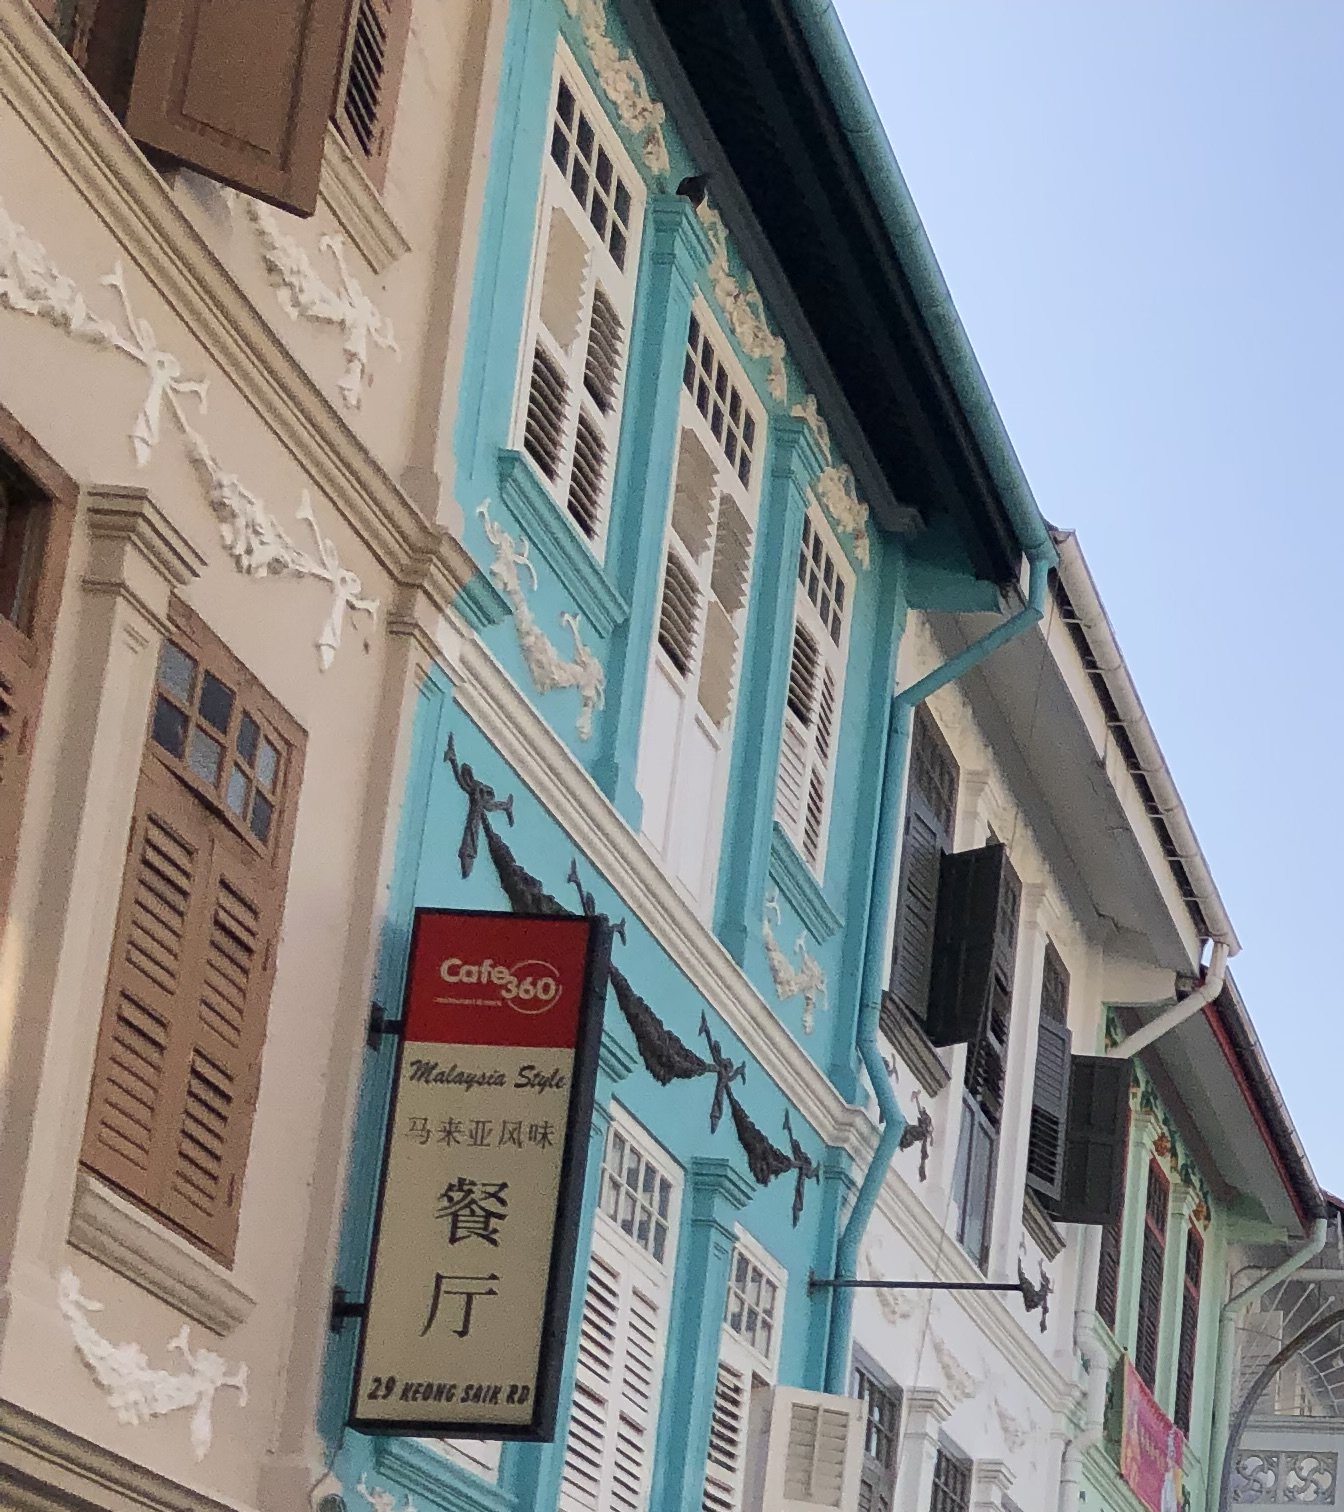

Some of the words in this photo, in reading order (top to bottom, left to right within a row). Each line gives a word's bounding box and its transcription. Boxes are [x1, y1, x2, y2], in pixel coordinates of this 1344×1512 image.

[440, 958, 511, 985] Cafe
[502, 976, 556, 1000] 360
[410, 1060, 507, 1092] Malaysia
[514, 1065, 567, 1094] Style
[405, 1117, 555, 1149] 马来亚风味
[419, 1177, 509, 1338] 餐厅
[367, 1377, 397, 1400] 29
[400, 1382, 456, 1402] KEONG
[461, 1384, 499, 1405] SAIK
[506, 1385, 530, 1404] RD
